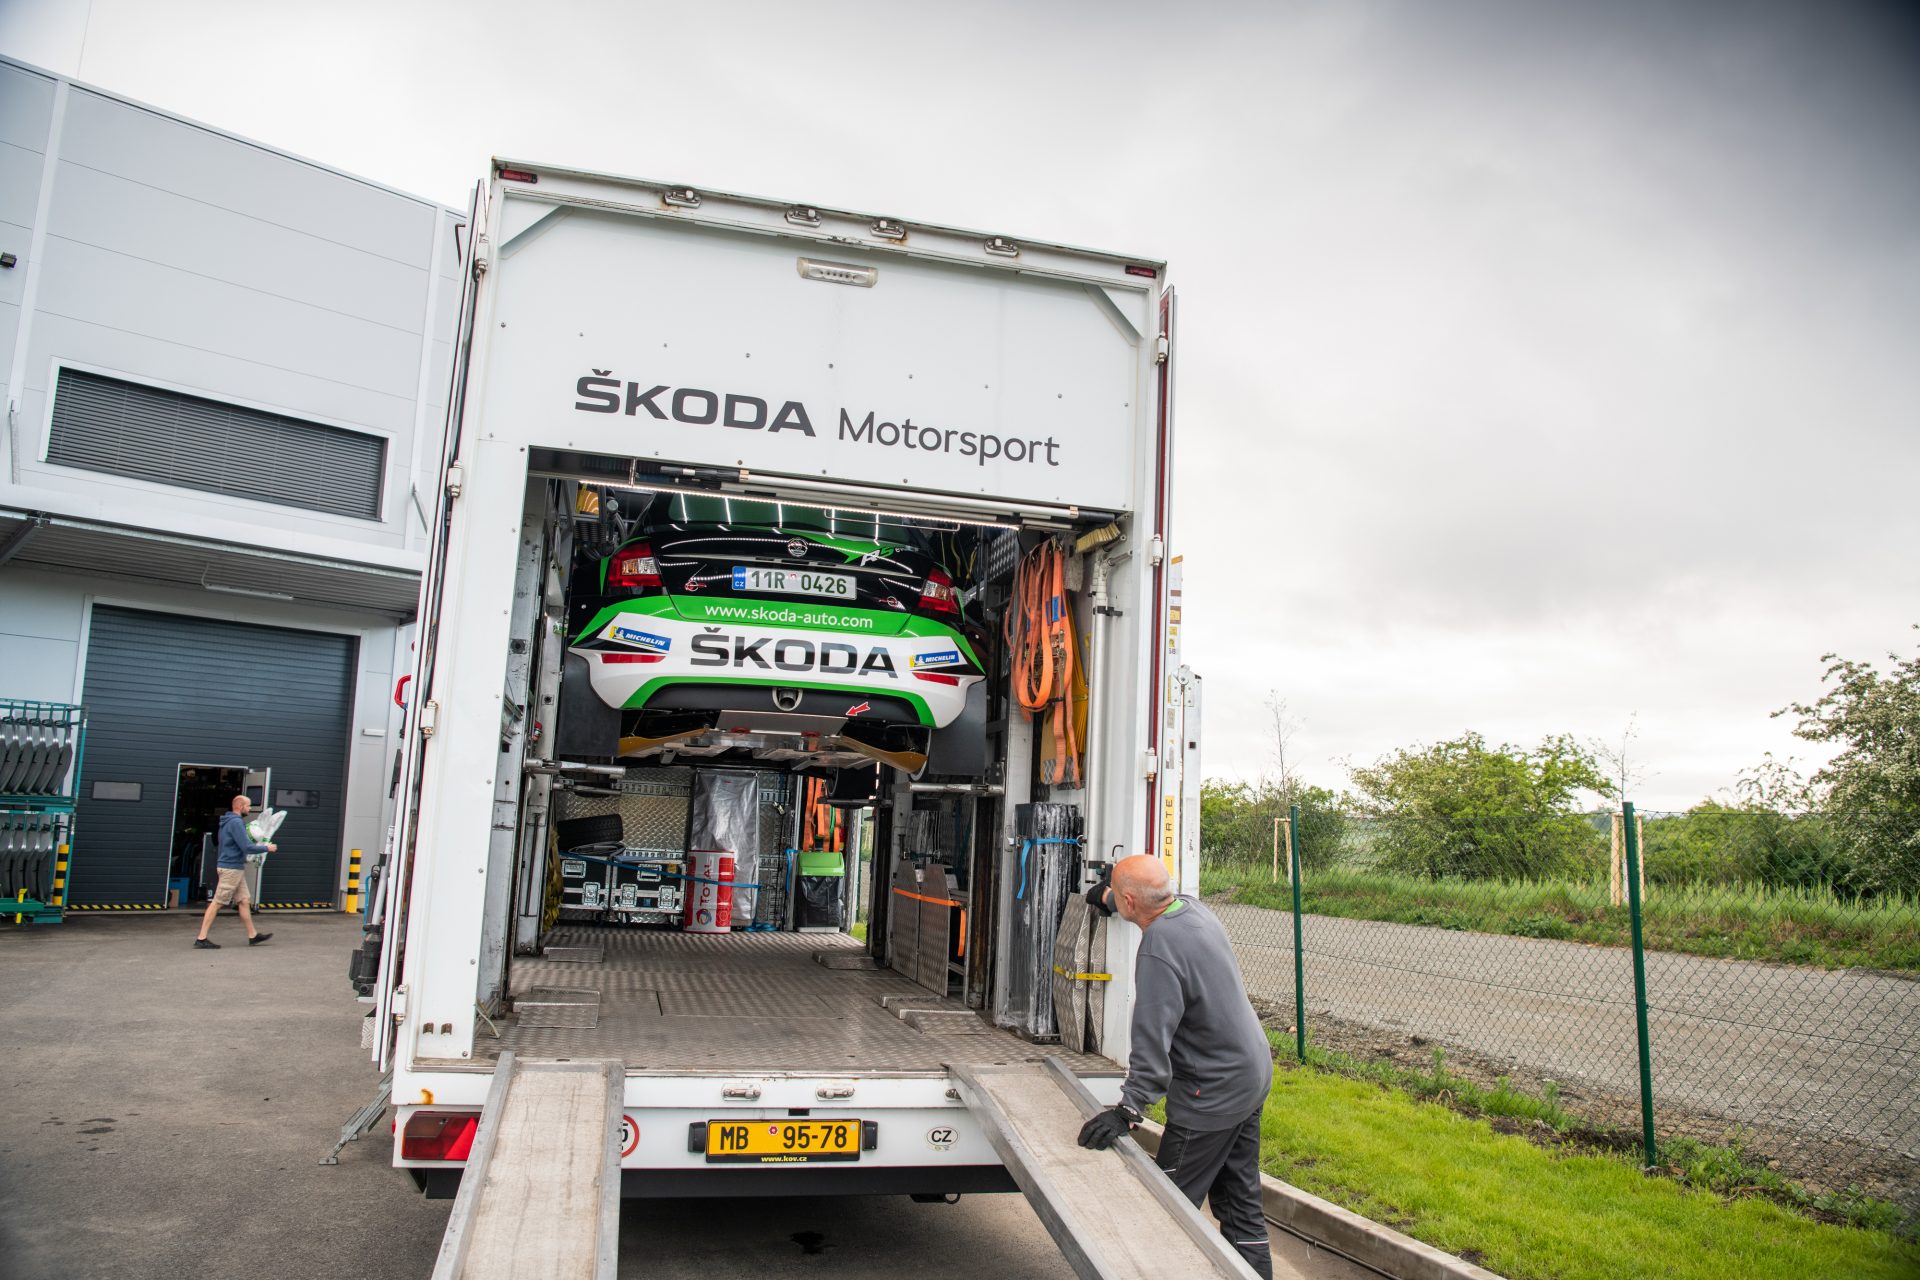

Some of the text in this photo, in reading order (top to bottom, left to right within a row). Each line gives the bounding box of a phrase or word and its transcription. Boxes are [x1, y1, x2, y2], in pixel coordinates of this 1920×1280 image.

[575, 368, 1060, 466] ŠKODA Motorsport
[751, 570, 847, 595] 11R 0426
[705, 605, 873, 629] www.skoda-auto.com
[625, 633, 666, 646] MICHELIN
[690, 626, 899, 679] ŠKODA
[925, 654, 956, 663] MICHELIN
[1165, 799, 1173, 857] FORTE
[720, 1125, 848, 1150] MB 95-78
[931, 1129, 952, 1143] CZ
